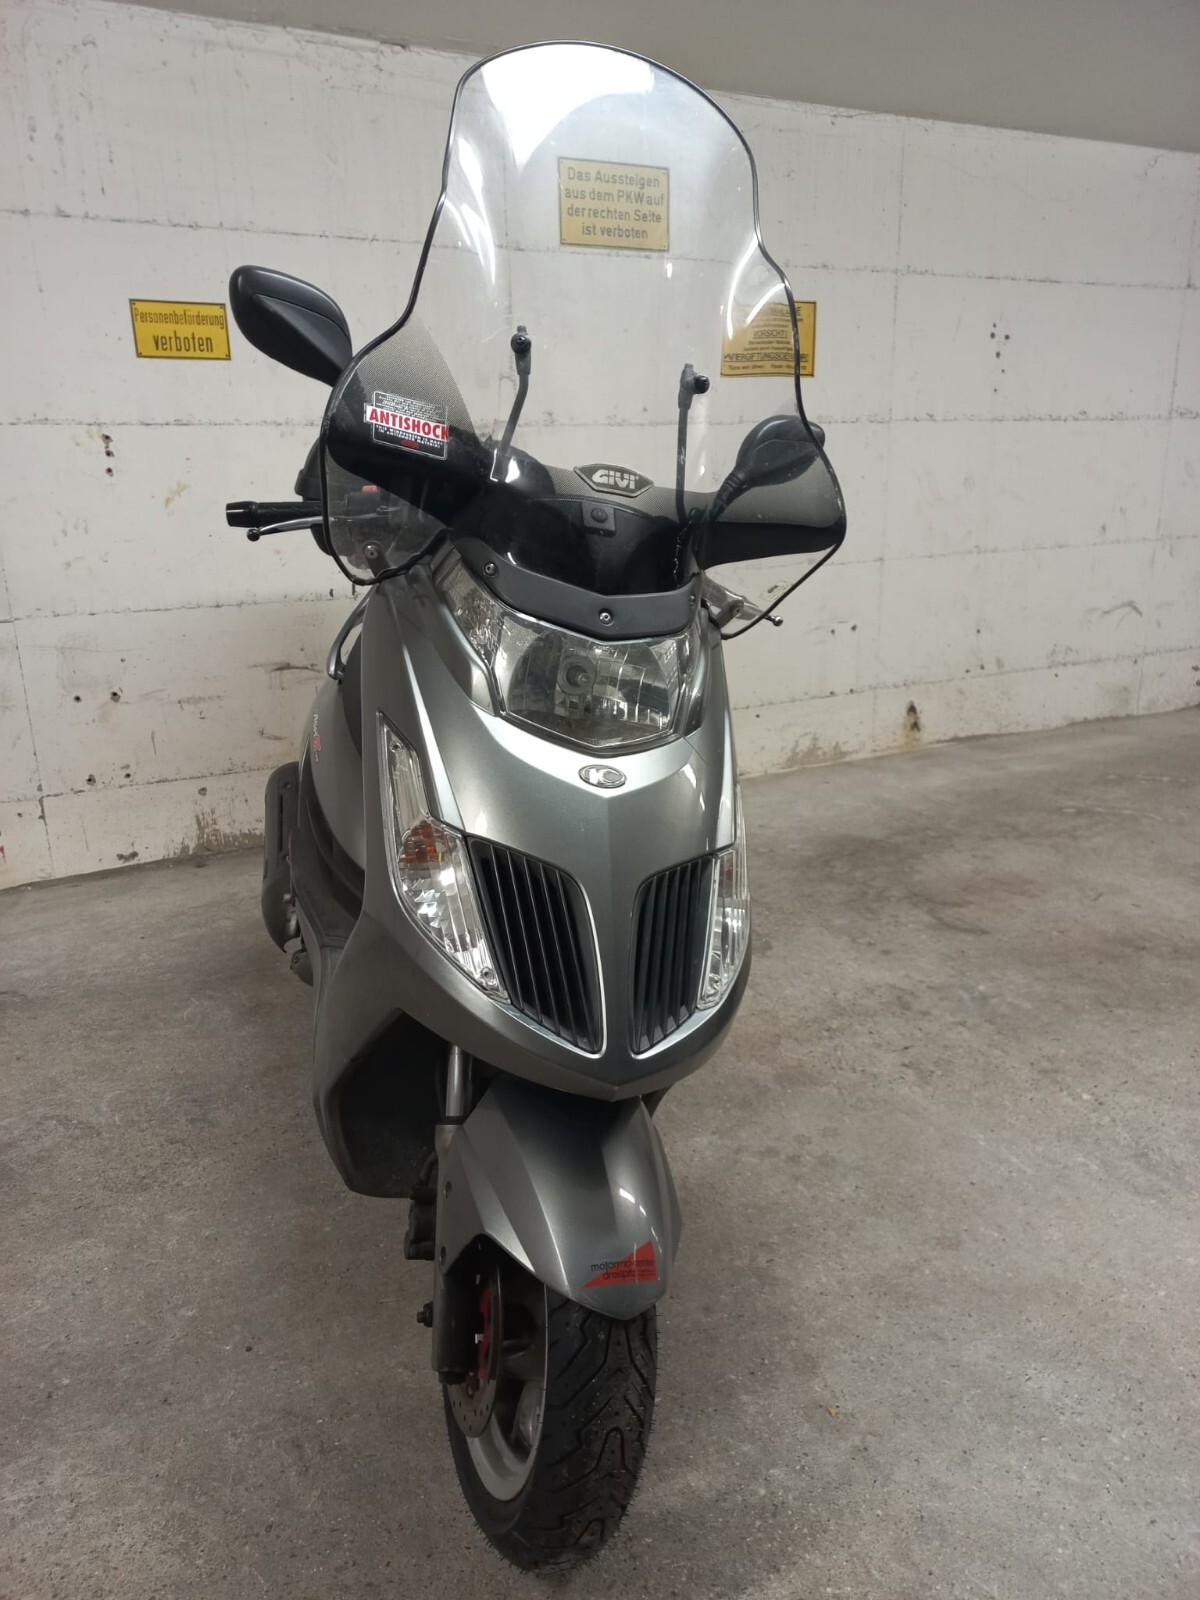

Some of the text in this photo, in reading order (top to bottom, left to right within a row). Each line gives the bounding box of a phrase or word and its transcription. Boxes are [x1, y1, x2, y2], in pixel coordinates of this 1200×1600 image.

[567, 166, 660, 190] Das Aussteigen
[564, 187, 665, 206] aus dem PKW auf
[567, 204, 662, 224] der rechten Seite
[581, 222, 648, 239] ist verboten
[152, 330, 214, 353] verboten
[368, 407, 449, 440] ANTISHOCK
